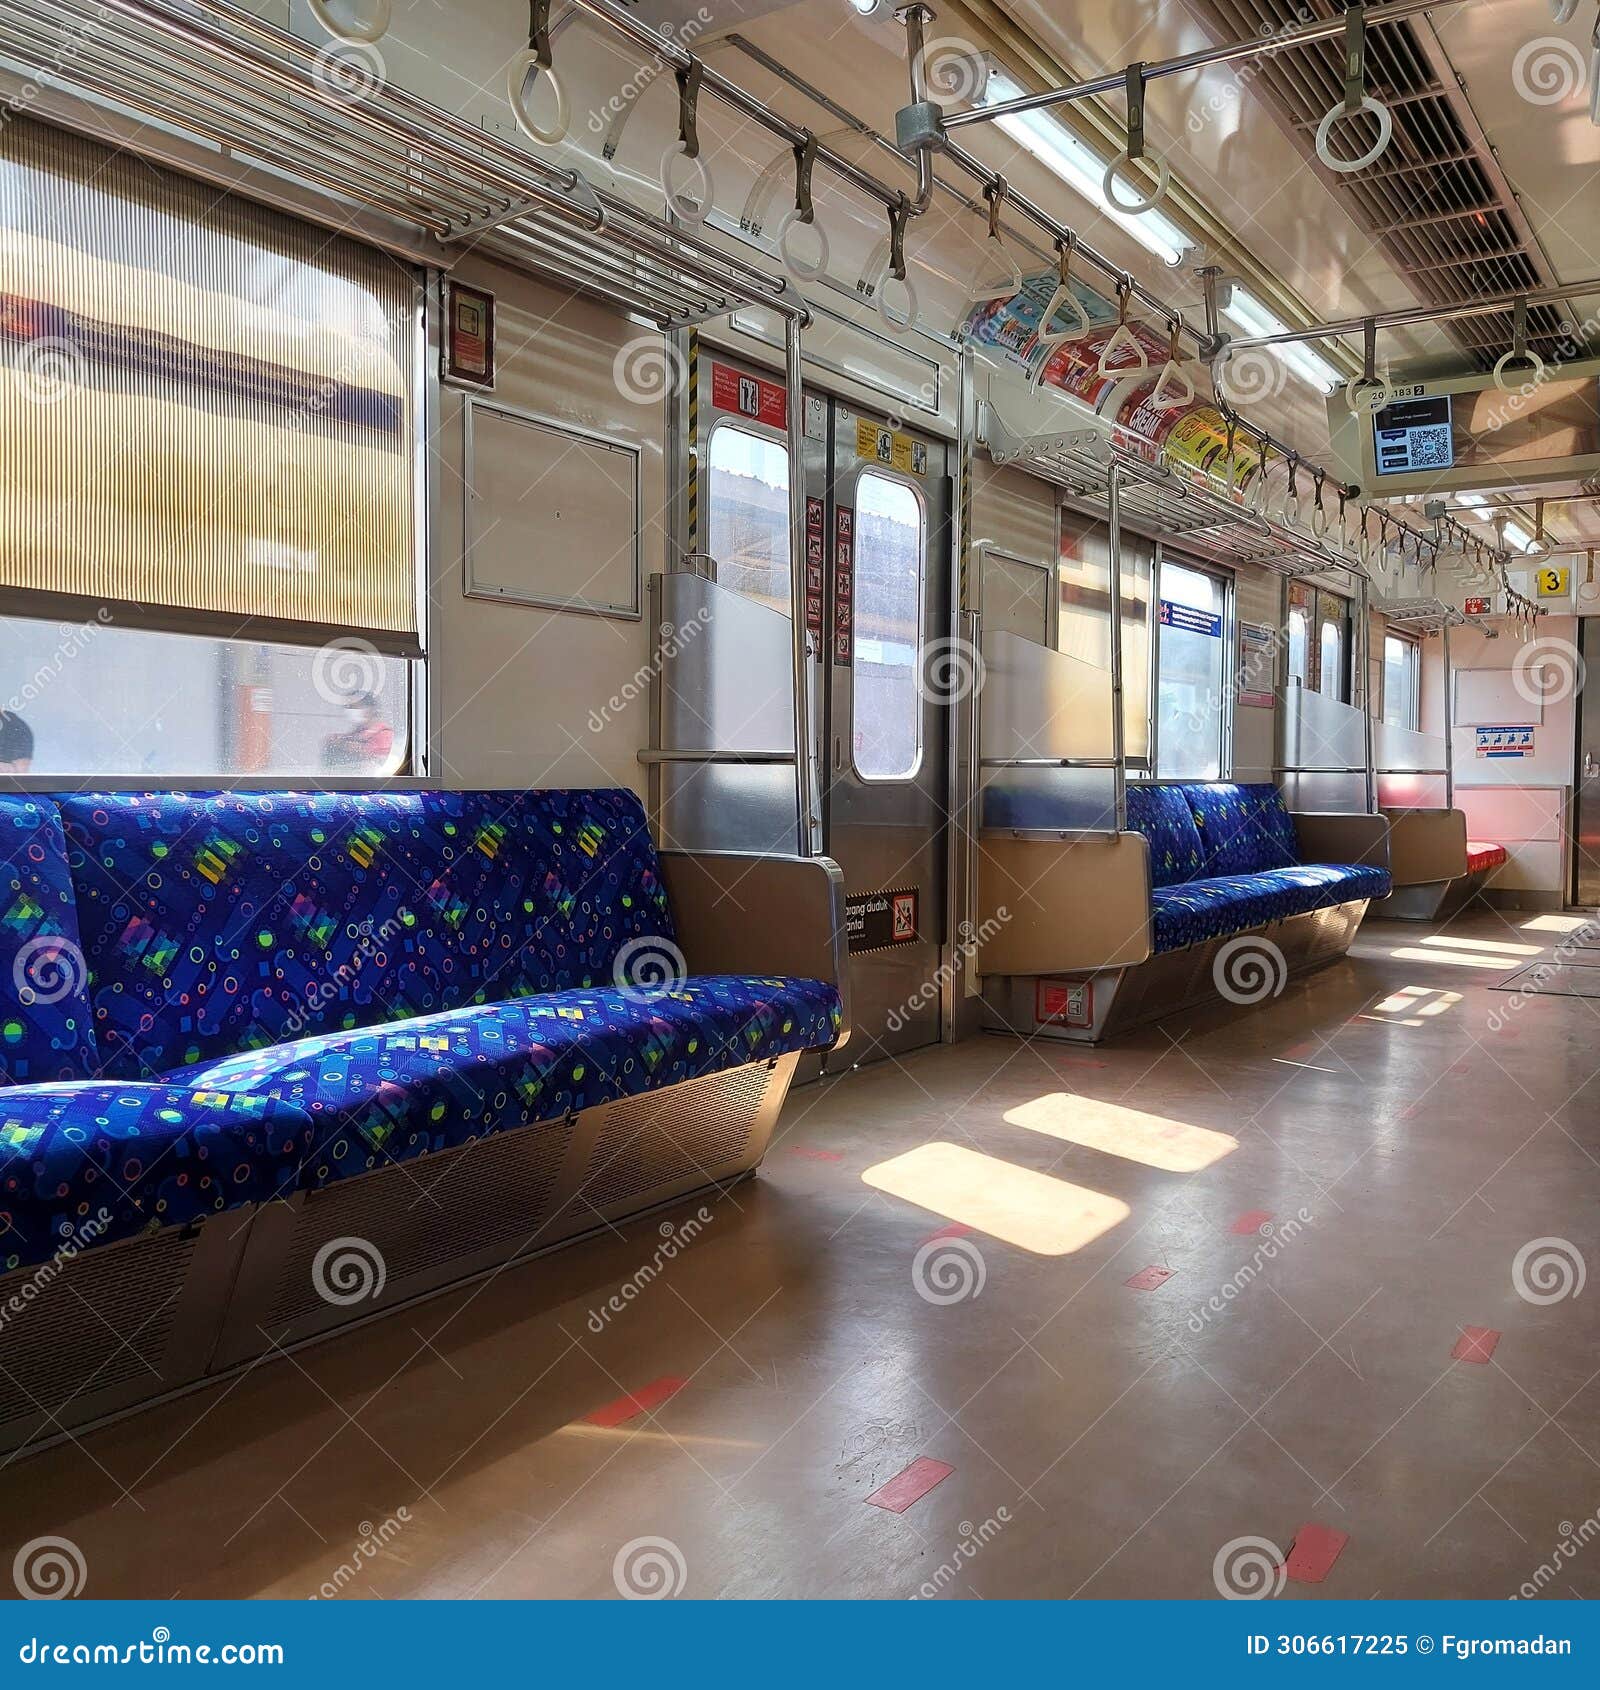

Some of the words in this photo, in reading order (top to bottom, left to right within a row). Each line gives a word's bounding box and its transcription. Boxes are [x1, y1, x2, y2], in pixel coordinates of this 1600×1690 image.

[1415, 386, 1423, 395] 2
[1129, 406, 1162, 438] CREAM
[1546, 571, 1560, 591] 3
[866, 900, 888, 913] duduk
